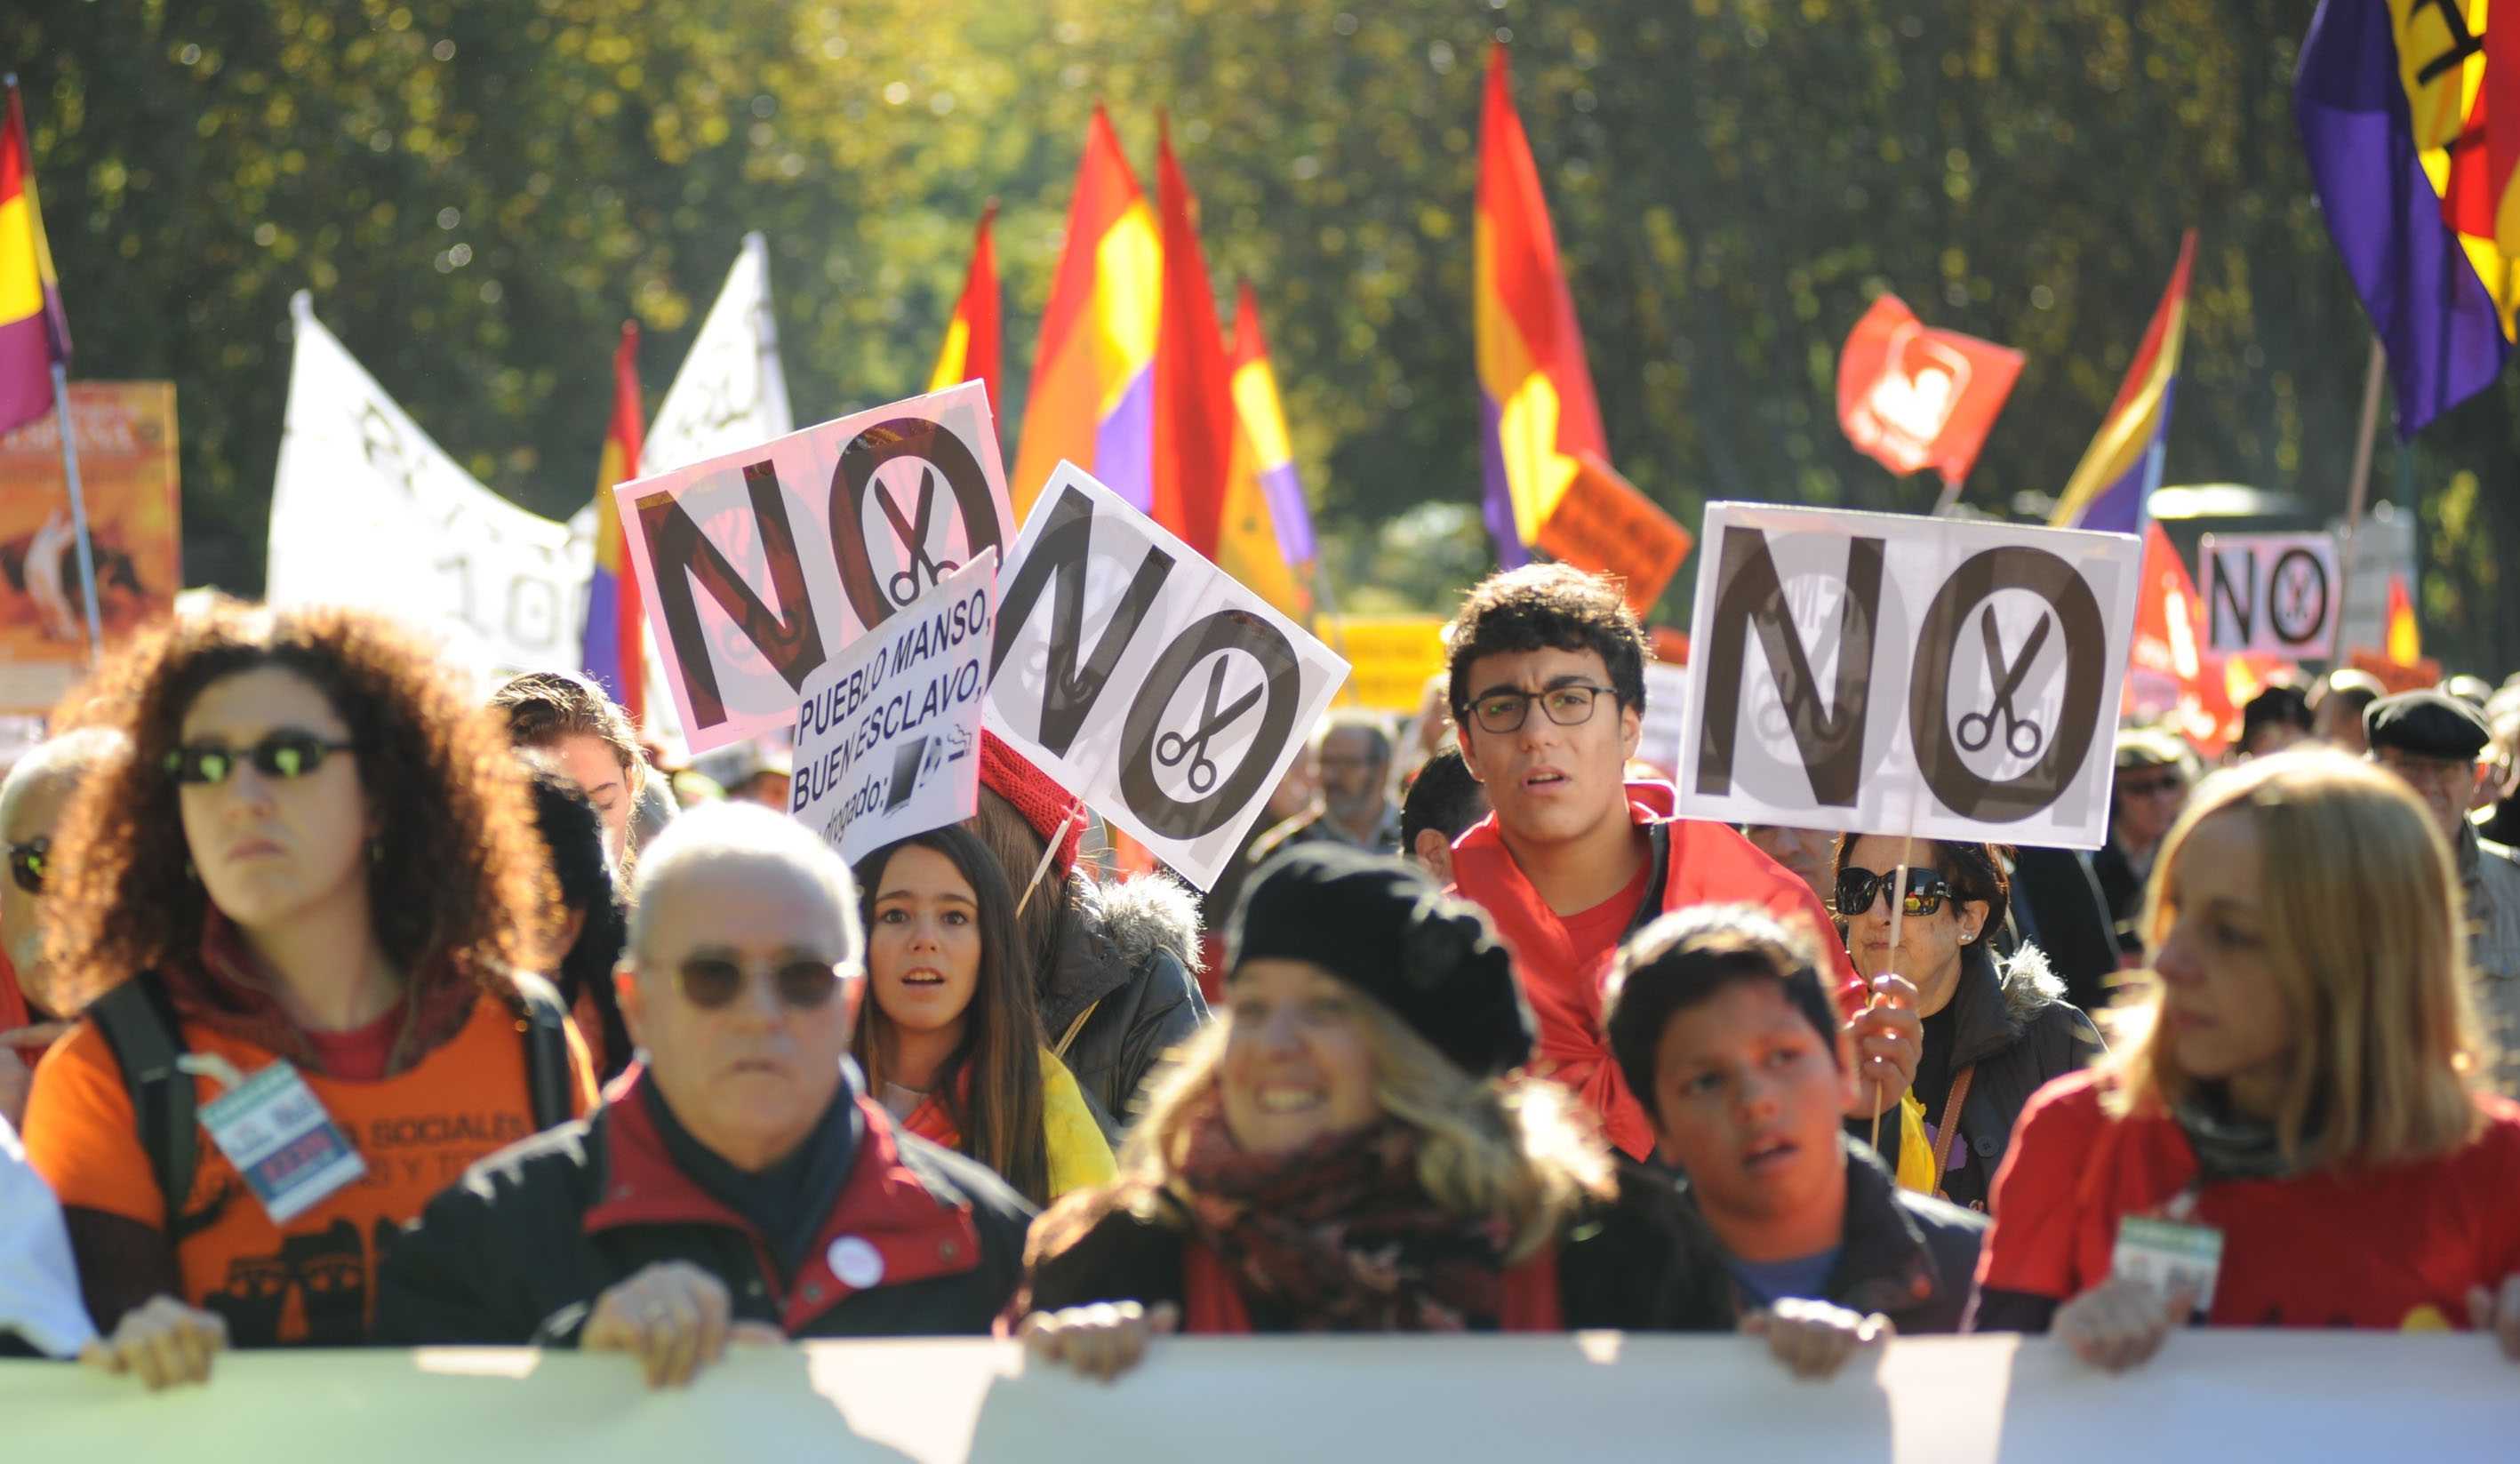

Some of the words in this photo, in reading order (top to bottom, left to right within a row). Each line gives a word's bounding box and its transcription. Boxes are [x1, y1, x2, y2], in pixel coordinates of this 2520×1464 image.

[636, 417, 1004, 730] NO
[798, 646, 888, 747] PUEBLO
[890, 588, 991, 678] MANSO,
[992, 484, 1301, 840] NO
[1695, 525, 2107, 824] NO
[2212, 548, 2328, 644] NO
[793, 731, 859, 814] BUEN
[853, 659, 982, 762] ESCLAVO,
